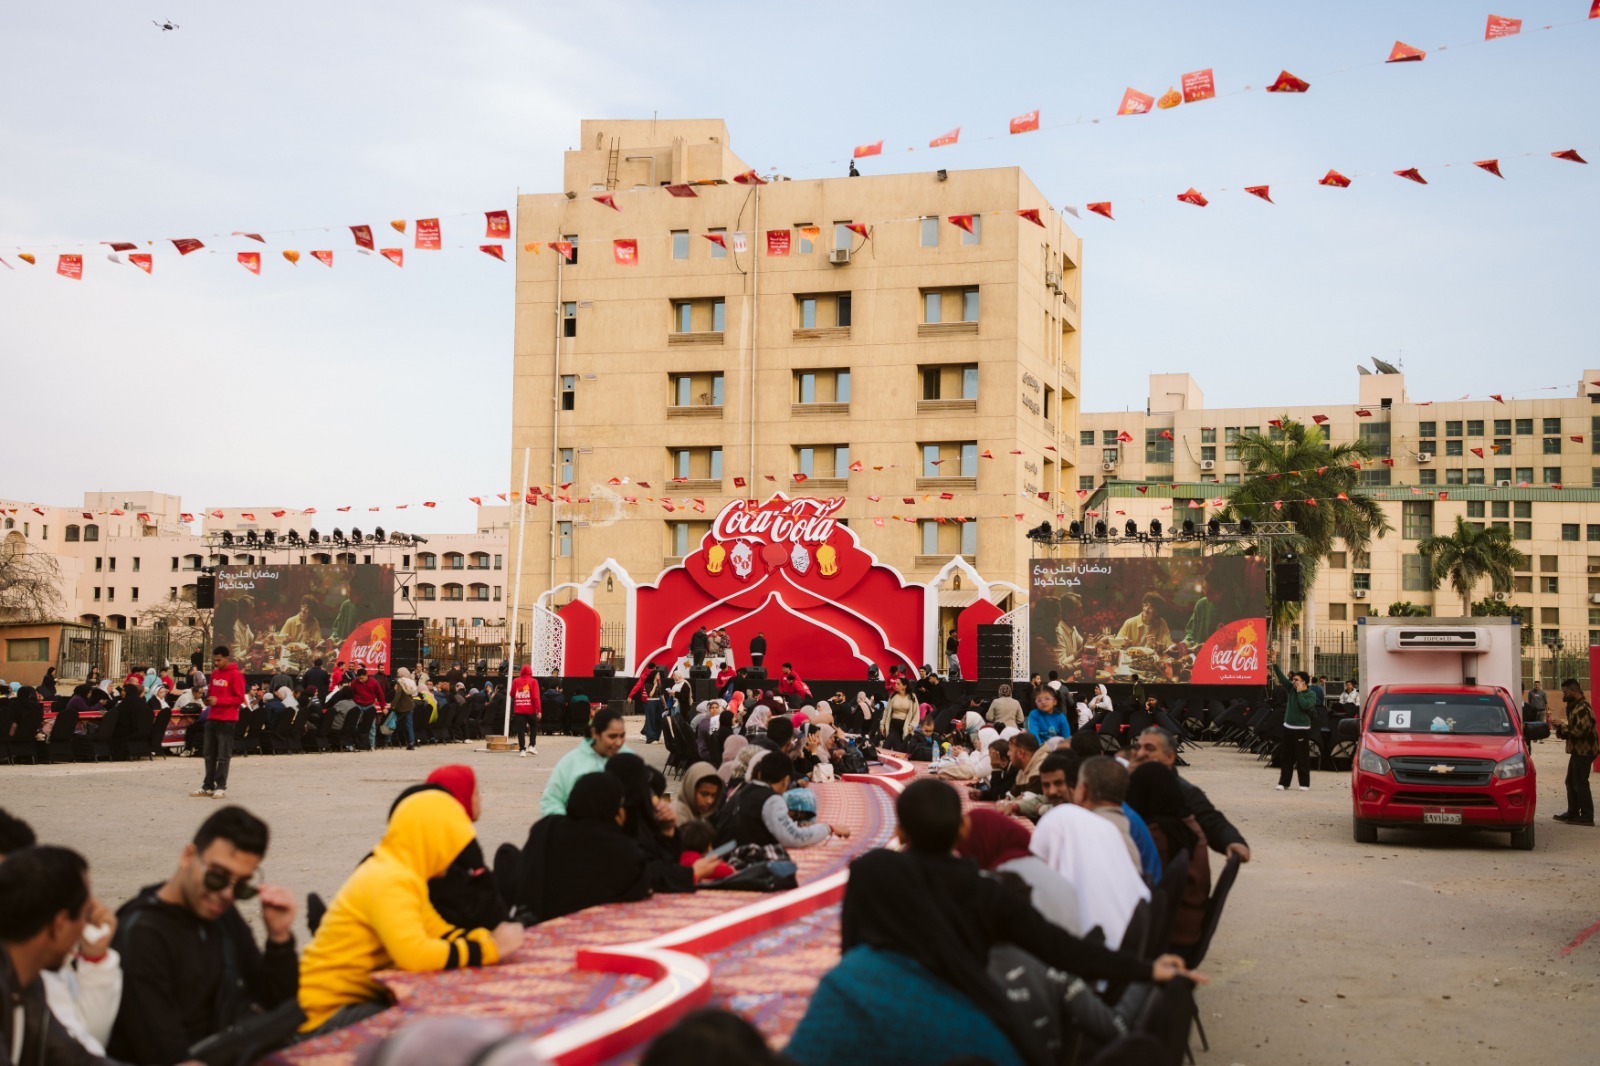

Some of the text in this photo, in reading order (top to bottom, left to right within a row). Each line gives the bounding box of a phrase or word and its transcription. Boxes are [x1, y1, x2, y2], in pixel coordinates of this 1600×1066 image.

[712, 497, 845, 545] Coca-Cola
[1033, 562, 1112, 575] رمضان أحلى مع
[218, 570, 230, 580] مع
[253, 571, 279, 580] رمضان
[218, 581, 255, 589] كوكاكولا
[1033, 577, 1081, 587] كوكاكولا
[1395, 713, 1405, 726] 6
